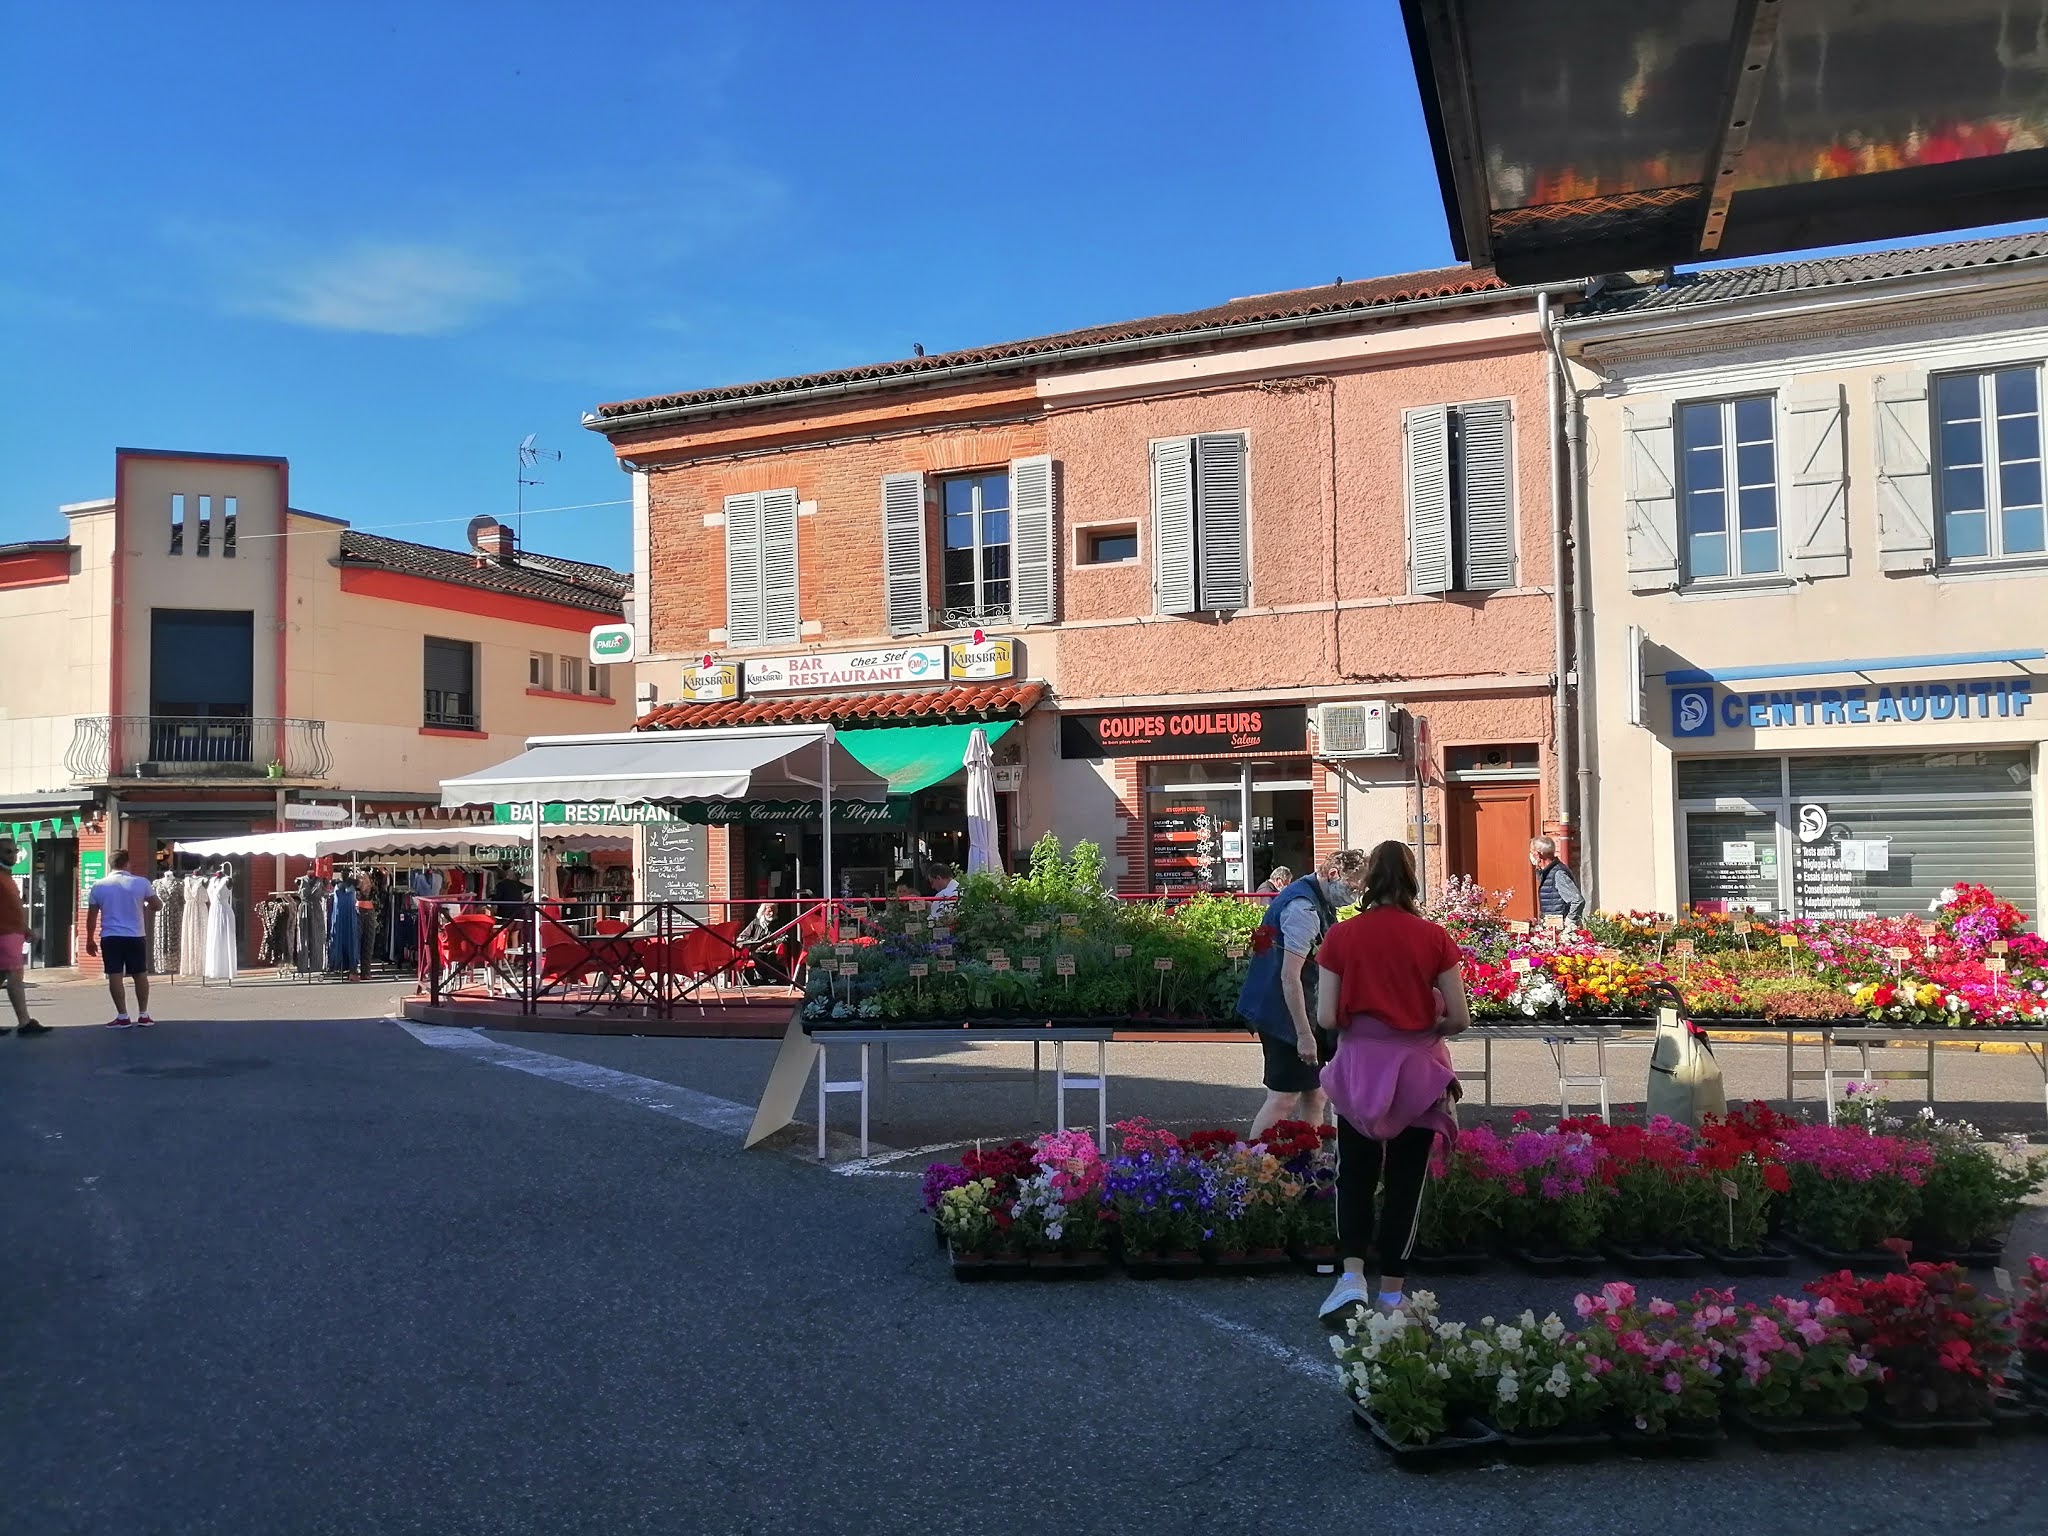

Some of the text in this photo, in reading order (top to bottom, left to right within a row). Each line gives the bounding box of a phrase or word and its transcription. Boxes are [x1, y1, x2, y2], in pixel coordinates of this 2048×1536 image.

[596, 640, 614, 649] PMU
[789, 658, 823, 672] BAR
[850, 650, 909, 668] Chez Stef
[789, 667, 904, 687] RESTAURANT
[1721, 680, 2032, 728] CENTRE AUDITIF
[1100, 712, 1262, 738] COUPES COULEURS
[1231, 733, 1261, 746] Salons
[565, 804, 683, 822] RESTAURANT
[707, 804, 742, 819] Chez
[749, 804, 814, 820] Camille
[1802, 846, 1816, 856] Tests
[1803, 859, 1826, 871] Réglages
[1803, 871, 1852, 881] Essais dans le bruit
[1804, 884, 1850, 894] Conseil assistance
[1805, 897, 1831, 908] Adaptation
[1805, 910, 1835, 919] Accessoires
[1836, 909, 1843, 919] TV
